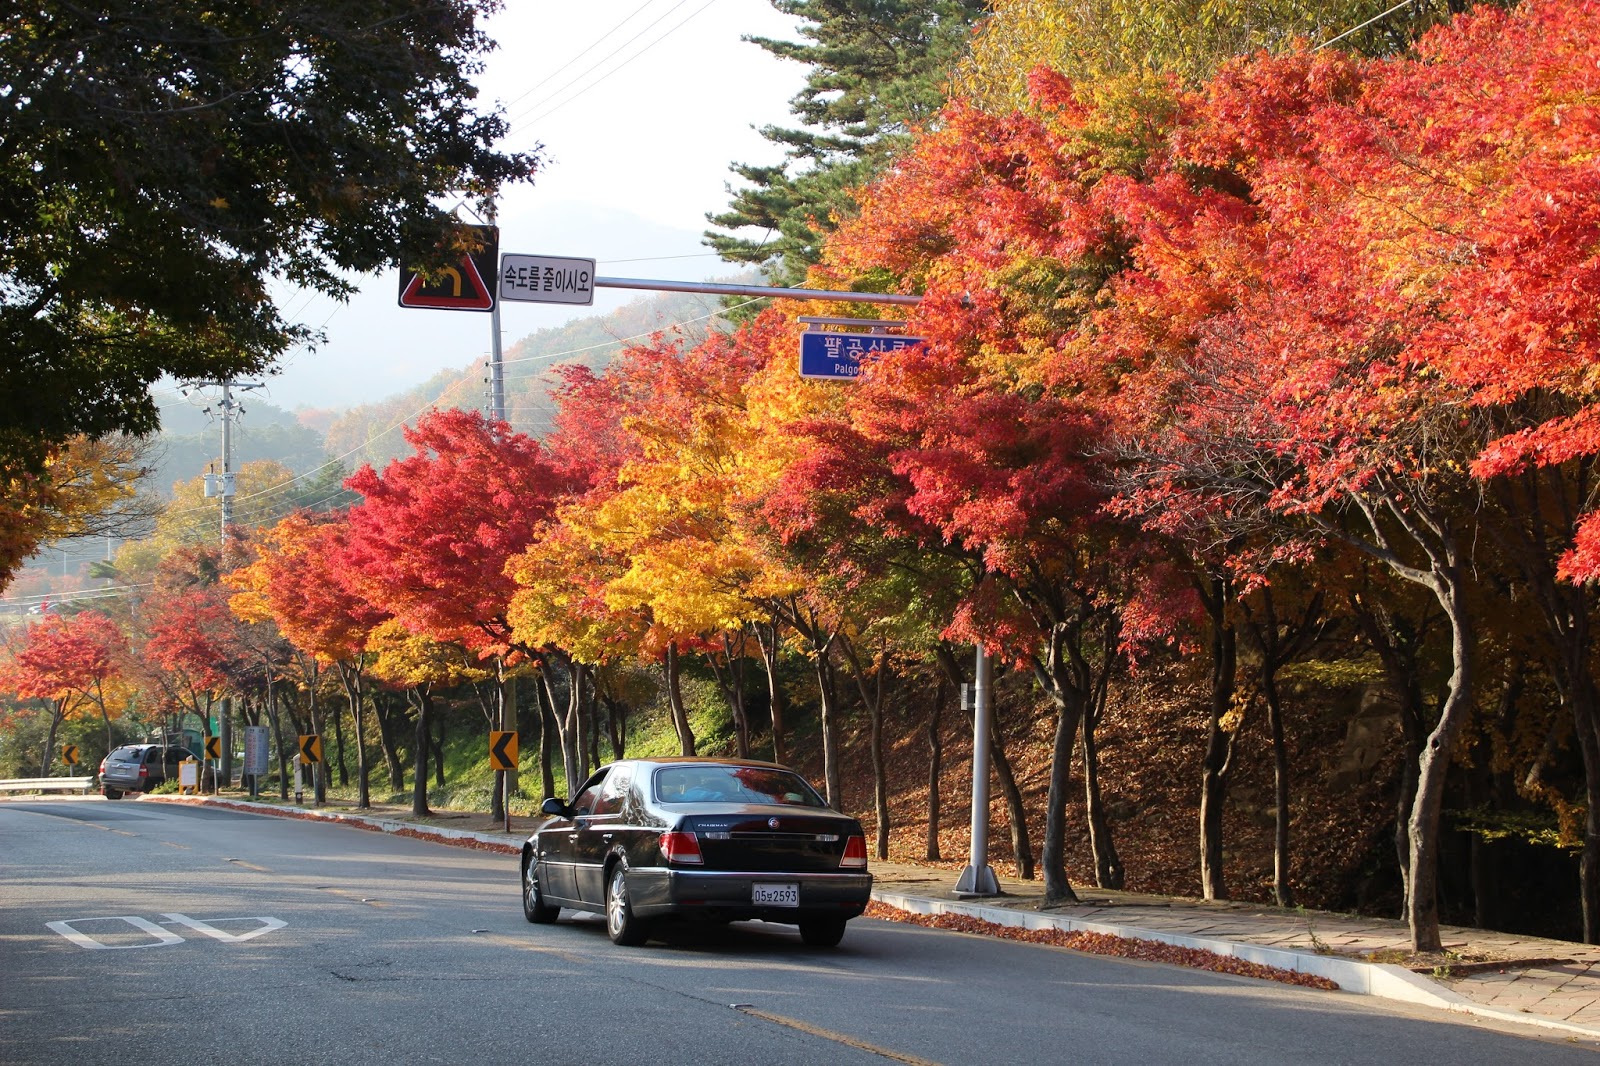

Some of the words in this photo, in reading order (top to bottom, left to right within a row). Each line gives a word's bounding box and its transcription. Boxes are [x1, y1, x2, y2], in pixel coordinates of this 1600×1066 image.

[504, 265, 541, 291] 속도를
[543, 267, 589, 293] 줄이시오
[834, 363, 861, 376] Palgo
